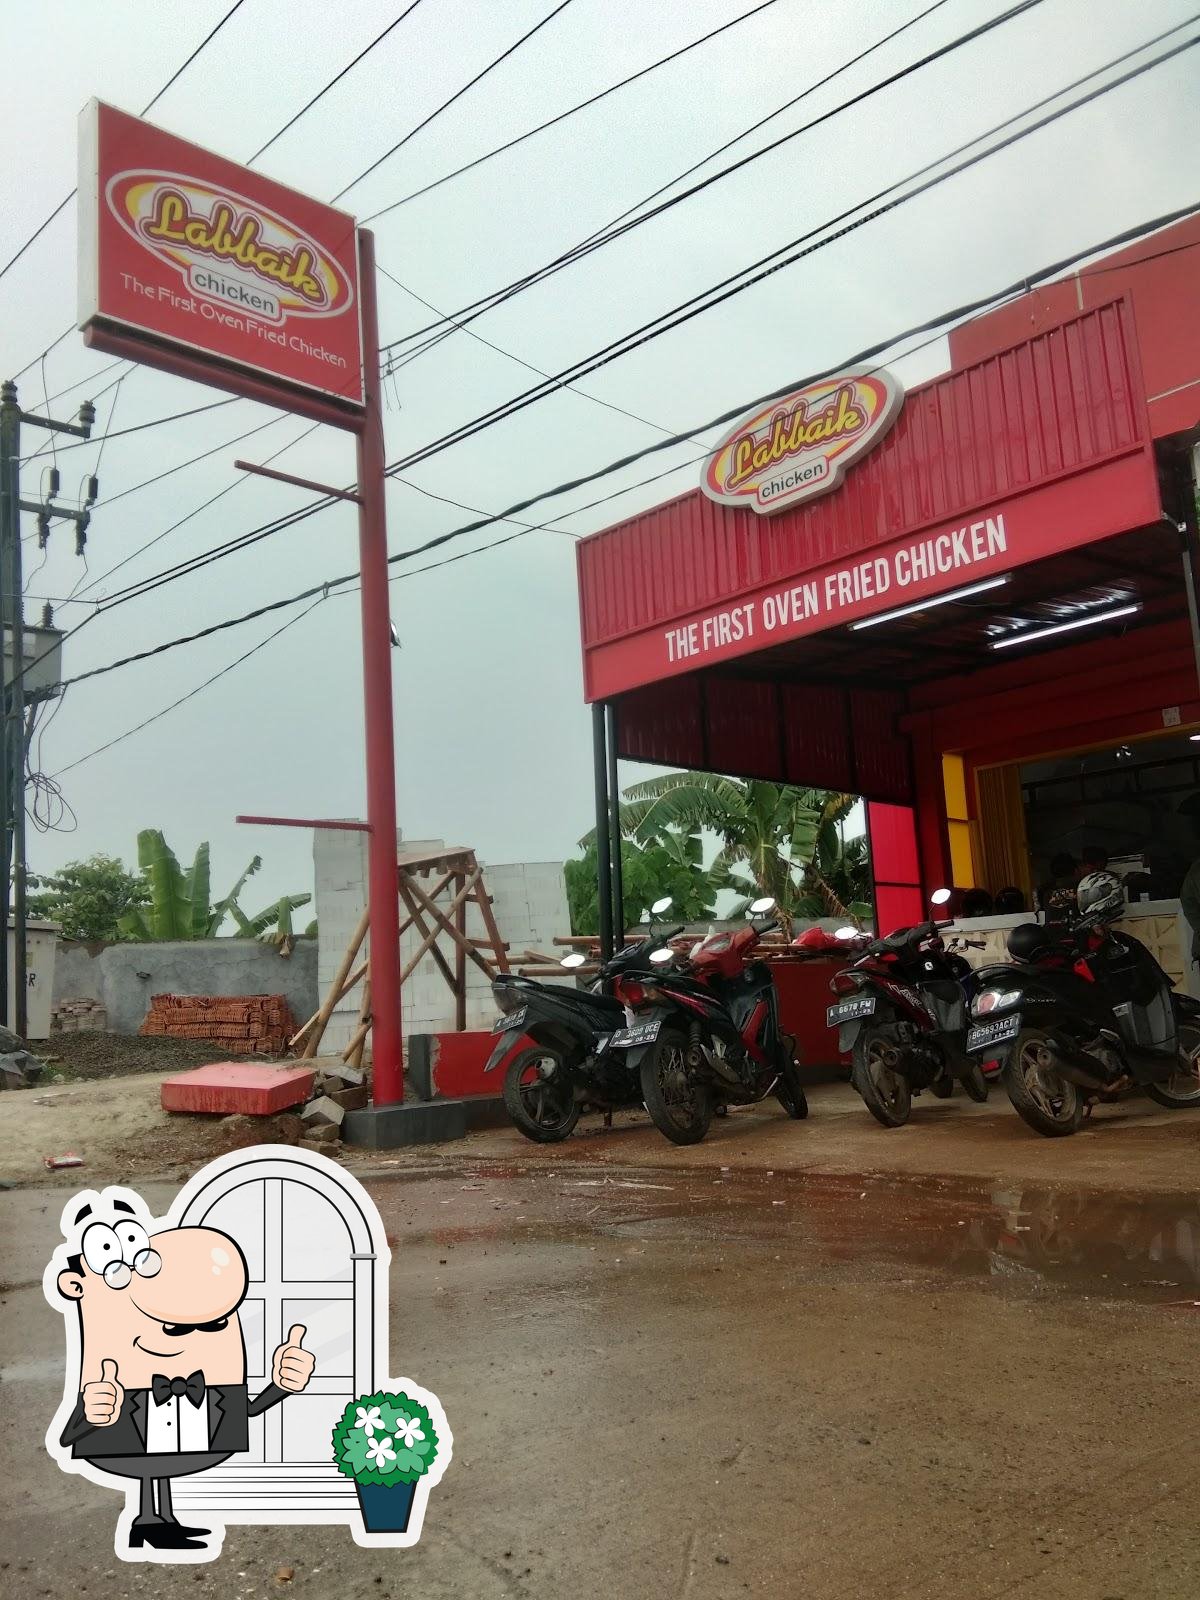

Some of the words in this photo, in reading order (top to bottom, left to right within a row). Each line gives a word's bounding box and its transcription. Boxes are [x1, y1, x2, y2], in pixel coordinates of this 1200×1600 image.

[146, 193, 321, 298] Labbaik
[194, 270, 275, 314] chicken
[120, 272, 155, 299] The
[157, 286, 197, 314] First
[199, 303, 244, 333] Oven
[246, 319, 287, 349] Fried
[289, 336, 346, 369] Chicken
[728, 385, 862, 484] Labbaik
[761, 462, 824, 499] chicken
[664, 622, 700, 663] THE
[702, 603, 755, 652] FIRST
[762, 580, 820, 631] OVEN
[824, 557, 890, 611] FRIED
[894, 513, 1008, 587] CHICKEN
